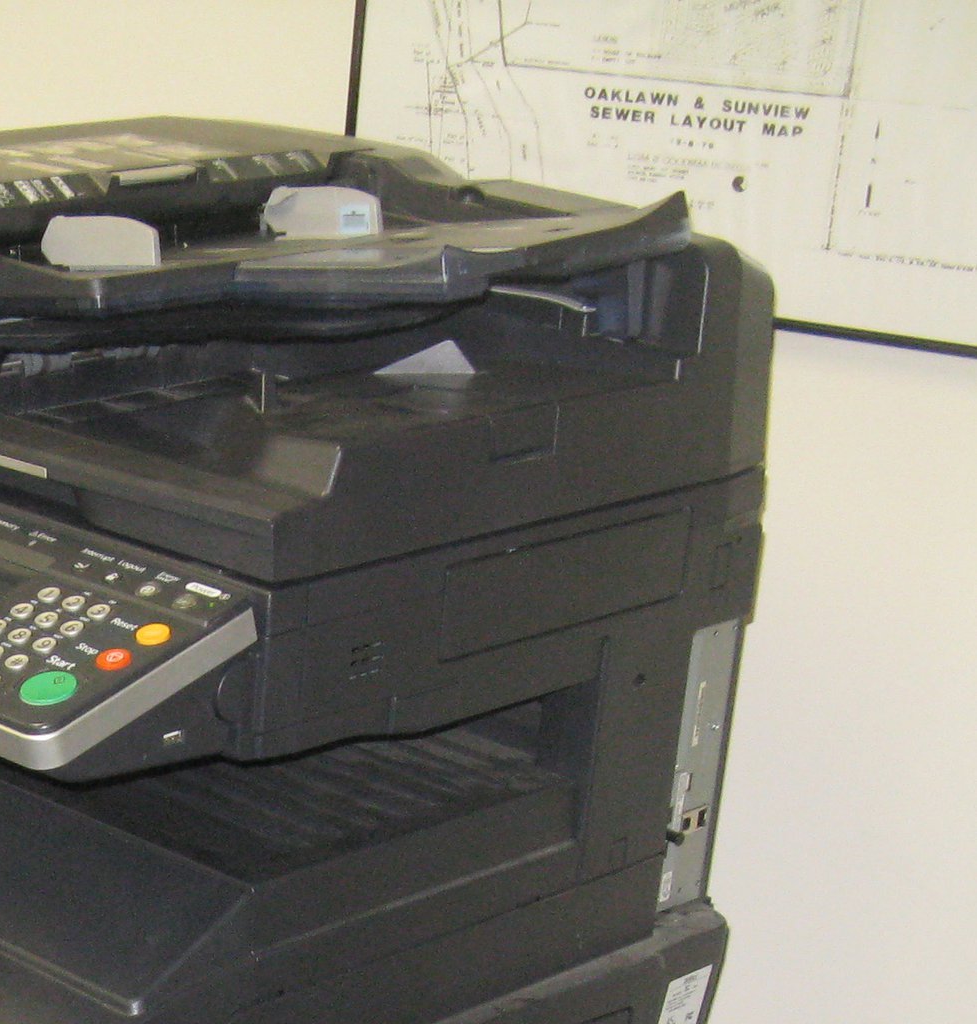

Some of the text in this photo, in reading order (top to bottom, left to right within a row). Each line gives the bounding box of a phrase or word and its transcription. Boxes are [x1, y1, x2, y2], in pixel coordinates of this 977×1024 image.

[584, 86, 811, 120] OAKLAWN & SUNVIEW
[590, 105, 804, 137] SEWER LAYOUT MAP
[110, 617, 138, 631] Reset
[75, 642, 99, 656] Stop
[45, 655, 77, 671] Start
